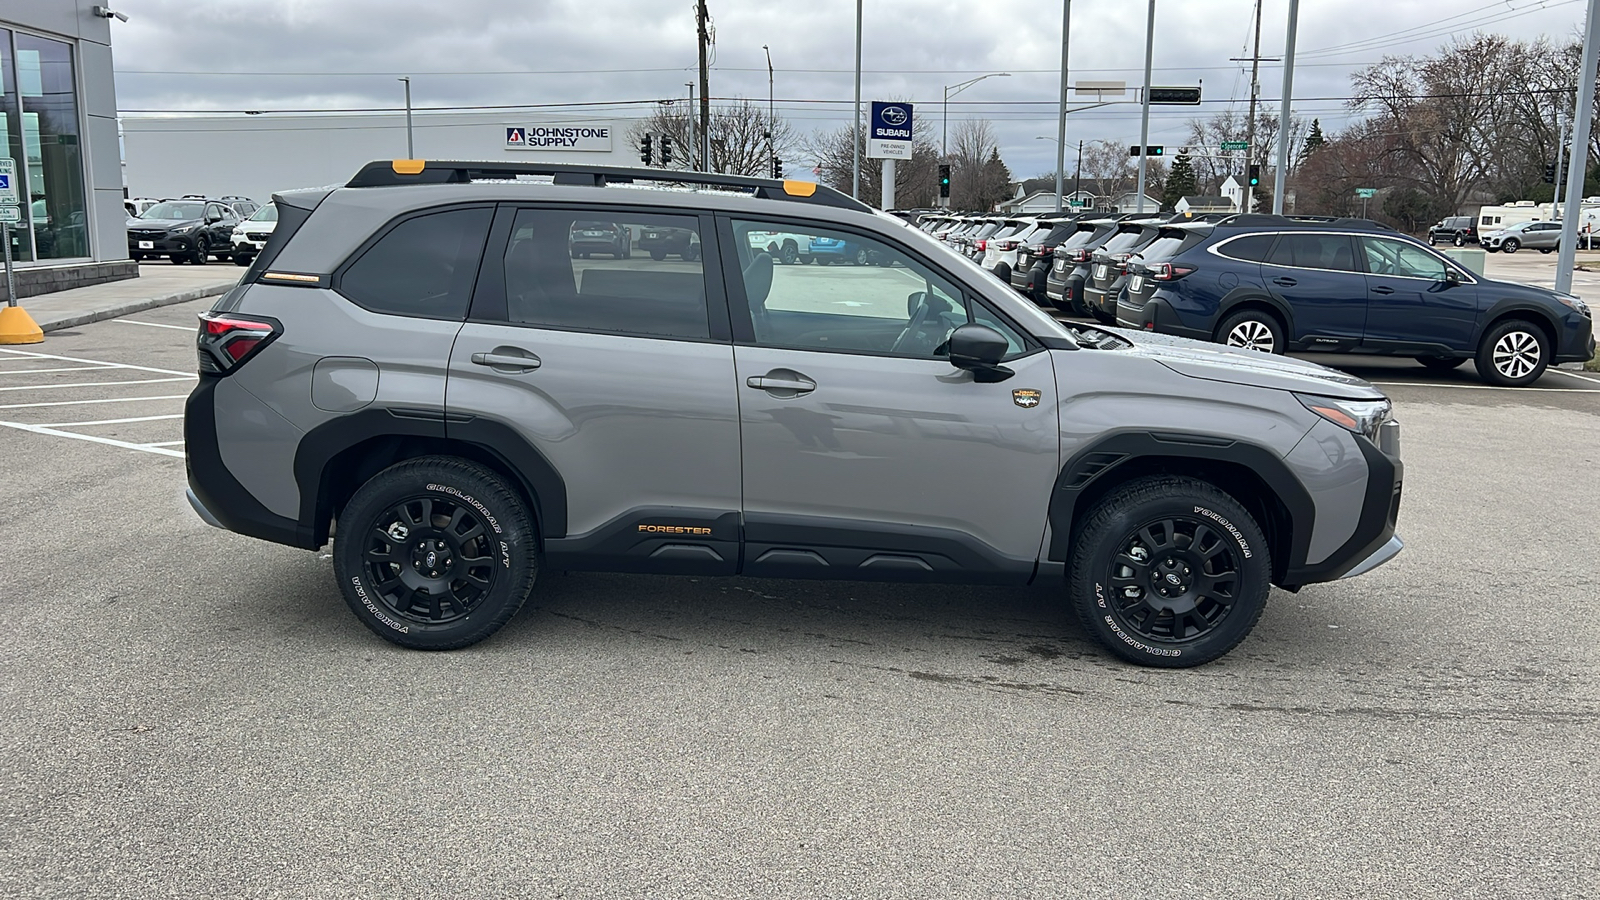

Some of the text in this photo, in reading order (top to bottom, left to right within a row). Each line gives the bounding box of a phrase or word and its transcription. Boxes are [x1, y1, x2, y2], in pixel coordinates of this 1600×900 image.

[528, 127, 608, 138] JOHNSTONE
[528, 138, 578, 147] SUPPLY
[876, 128, 910, 137] SUBARU
[426, 483, 510, 568] GEOLANDAR A/T
[638, 525, 712, 534] FORESTER
[1194, 506, 1252, 559] YOKOHAMA
[352, 576, 408, 633] YOKOHAMA
[1095, 583, 1181, 656] GEOLANDAR A/T
